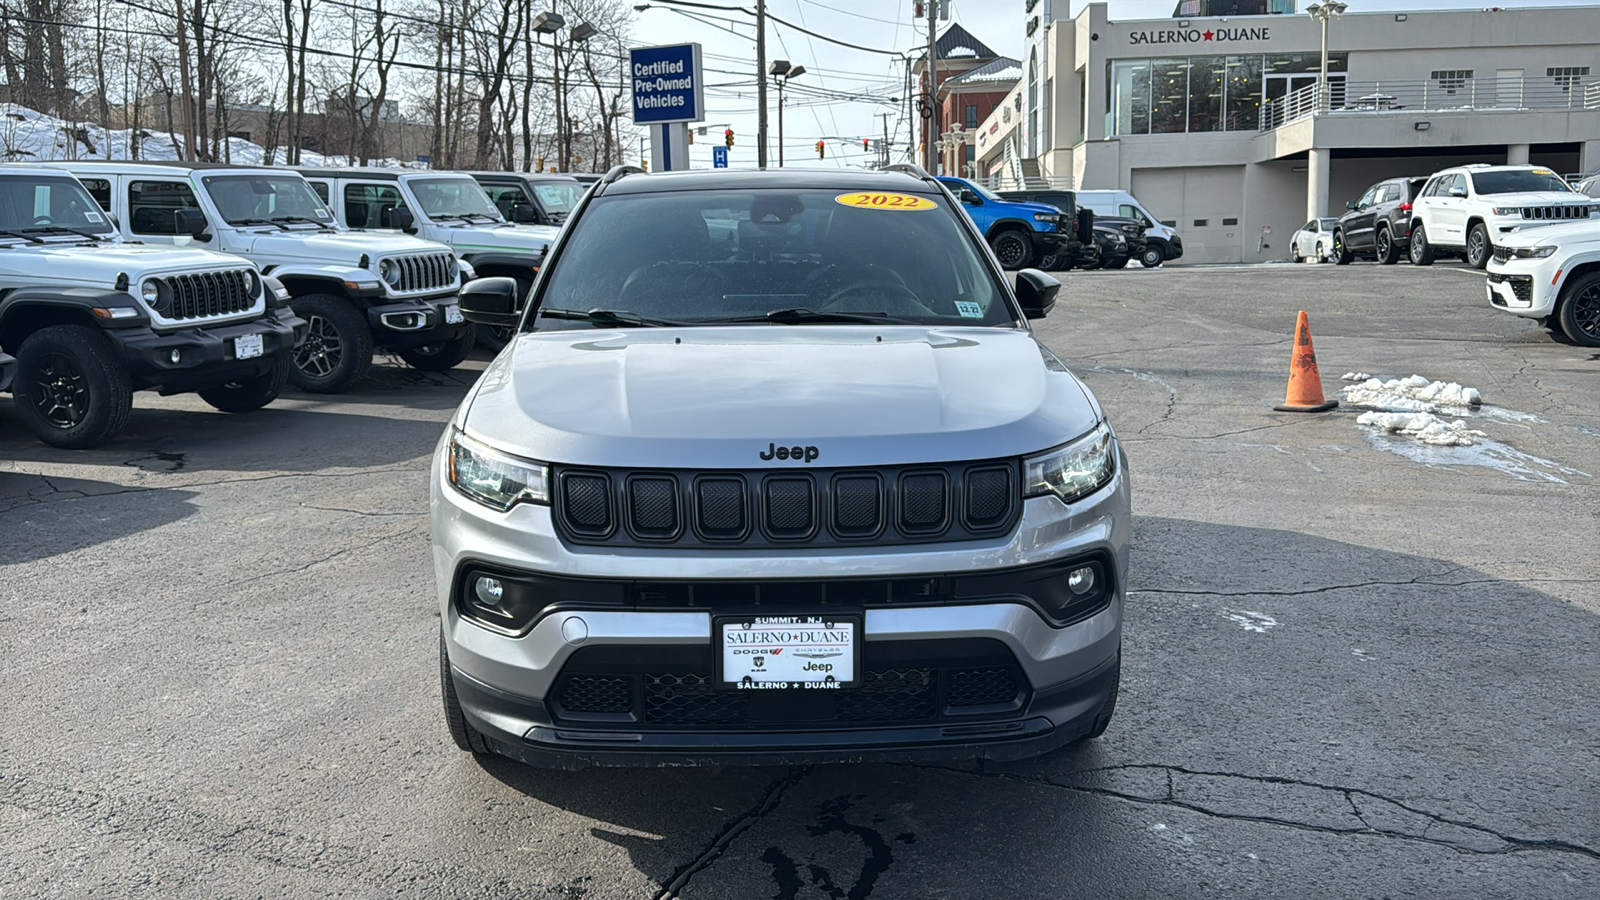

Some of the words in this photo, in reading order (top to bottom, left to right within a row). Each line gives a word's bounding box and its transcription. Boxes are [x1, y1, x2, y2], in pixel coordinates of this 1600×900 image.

[1129, 29, 1201, 45] SALERNO
[1216, 27, 1271, 42] DUANE
[634, 59, 684, 76] Certified
[634, 75, 692, 93] Pre-Owned
[636, 93, 685, 109] Vehicles
[715, 151, 725, 162] H
[854, 194, 919, 207] 2022
[759, 442, 819, 463] Jeep
[807, 616, 822, 624] NJ
[727, 631, 792, 644] SALERNO
[799, 631, 850, 643] DUANE
[803, 661, 833, 673] Jeep
[804, 681, 841, 689] DUANE
